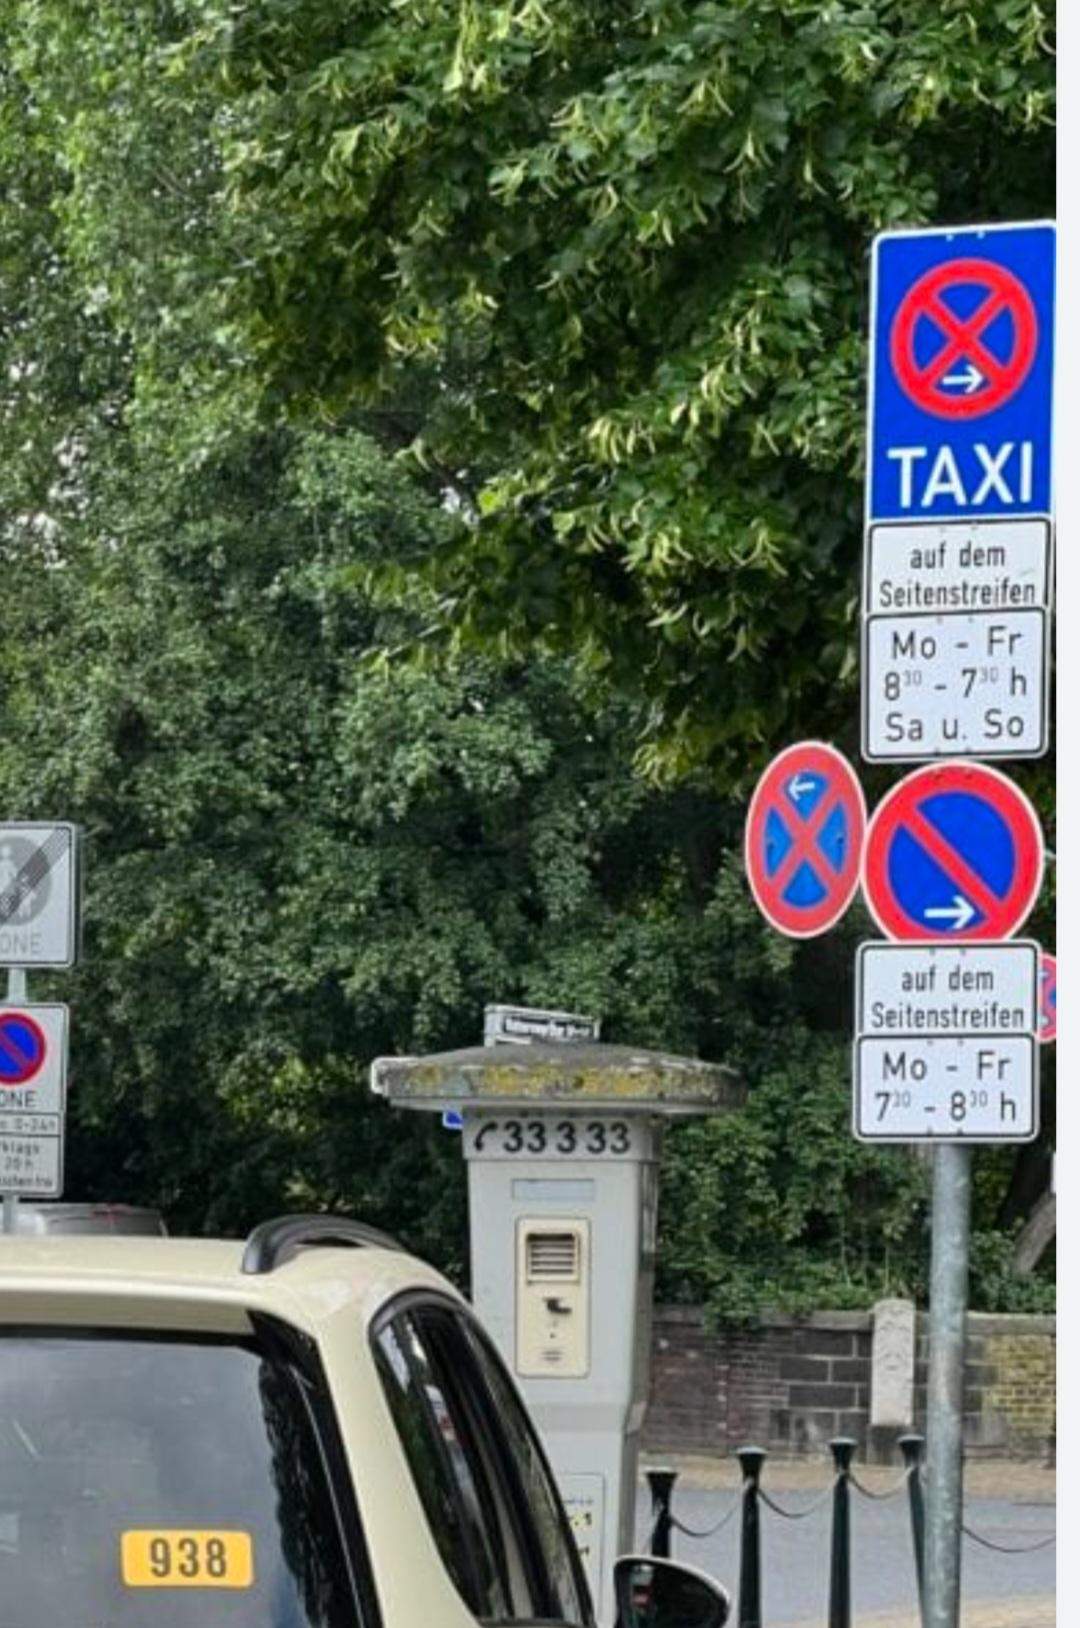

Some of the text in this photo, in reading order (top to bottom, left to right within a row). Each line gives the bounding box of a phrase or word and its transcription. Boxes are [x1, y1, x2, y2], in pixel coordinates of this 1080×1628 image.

[886, 441, 1033, 508] TAXI
[910, 541, 1005, 569] auf dem
[879, 577, 1035, 607] Seitenstreifen
[892, 630, 936, 660] Mo
[987, 626, 1023, 655] Fr
[1010, 667, 1027, 696] h
[885, 709, 1024, 742] Sa u. So
[902, 965, 994, 992] auf dem
[871, 1001, 1024, 1029] Seitenstreifen
[882, 1051, 927, 1081] Mo
[977, 1050, 1011, 1080] Fr
[1000, 1092, 1016, 1121] h
[150, 1538, 227, 1578] 938
